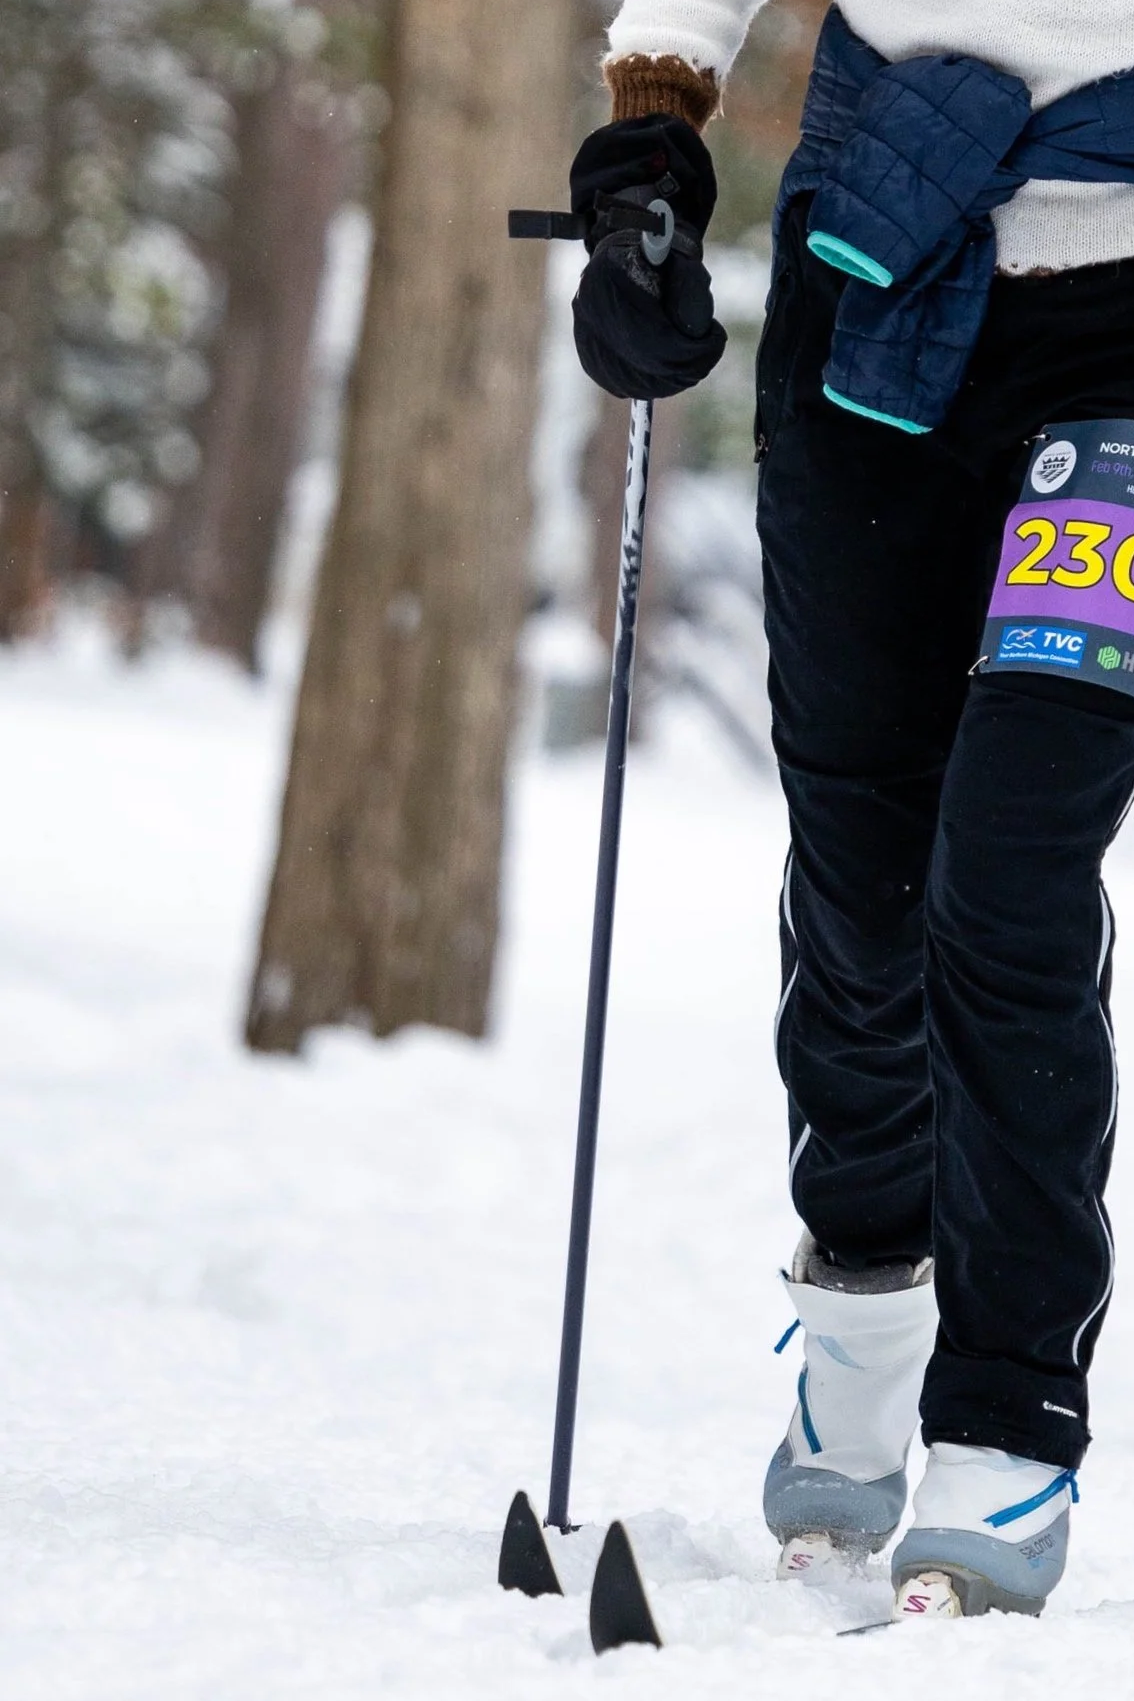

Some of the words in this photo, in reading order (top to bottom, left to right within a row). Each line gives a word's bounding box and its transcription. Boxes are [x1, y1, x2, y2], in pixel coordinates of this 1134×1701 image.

[1091, 459, 1111, 474] Feb
[1113, 462, 1134, 479] 9th,
[1043, 631, 1083, 652] TVC
